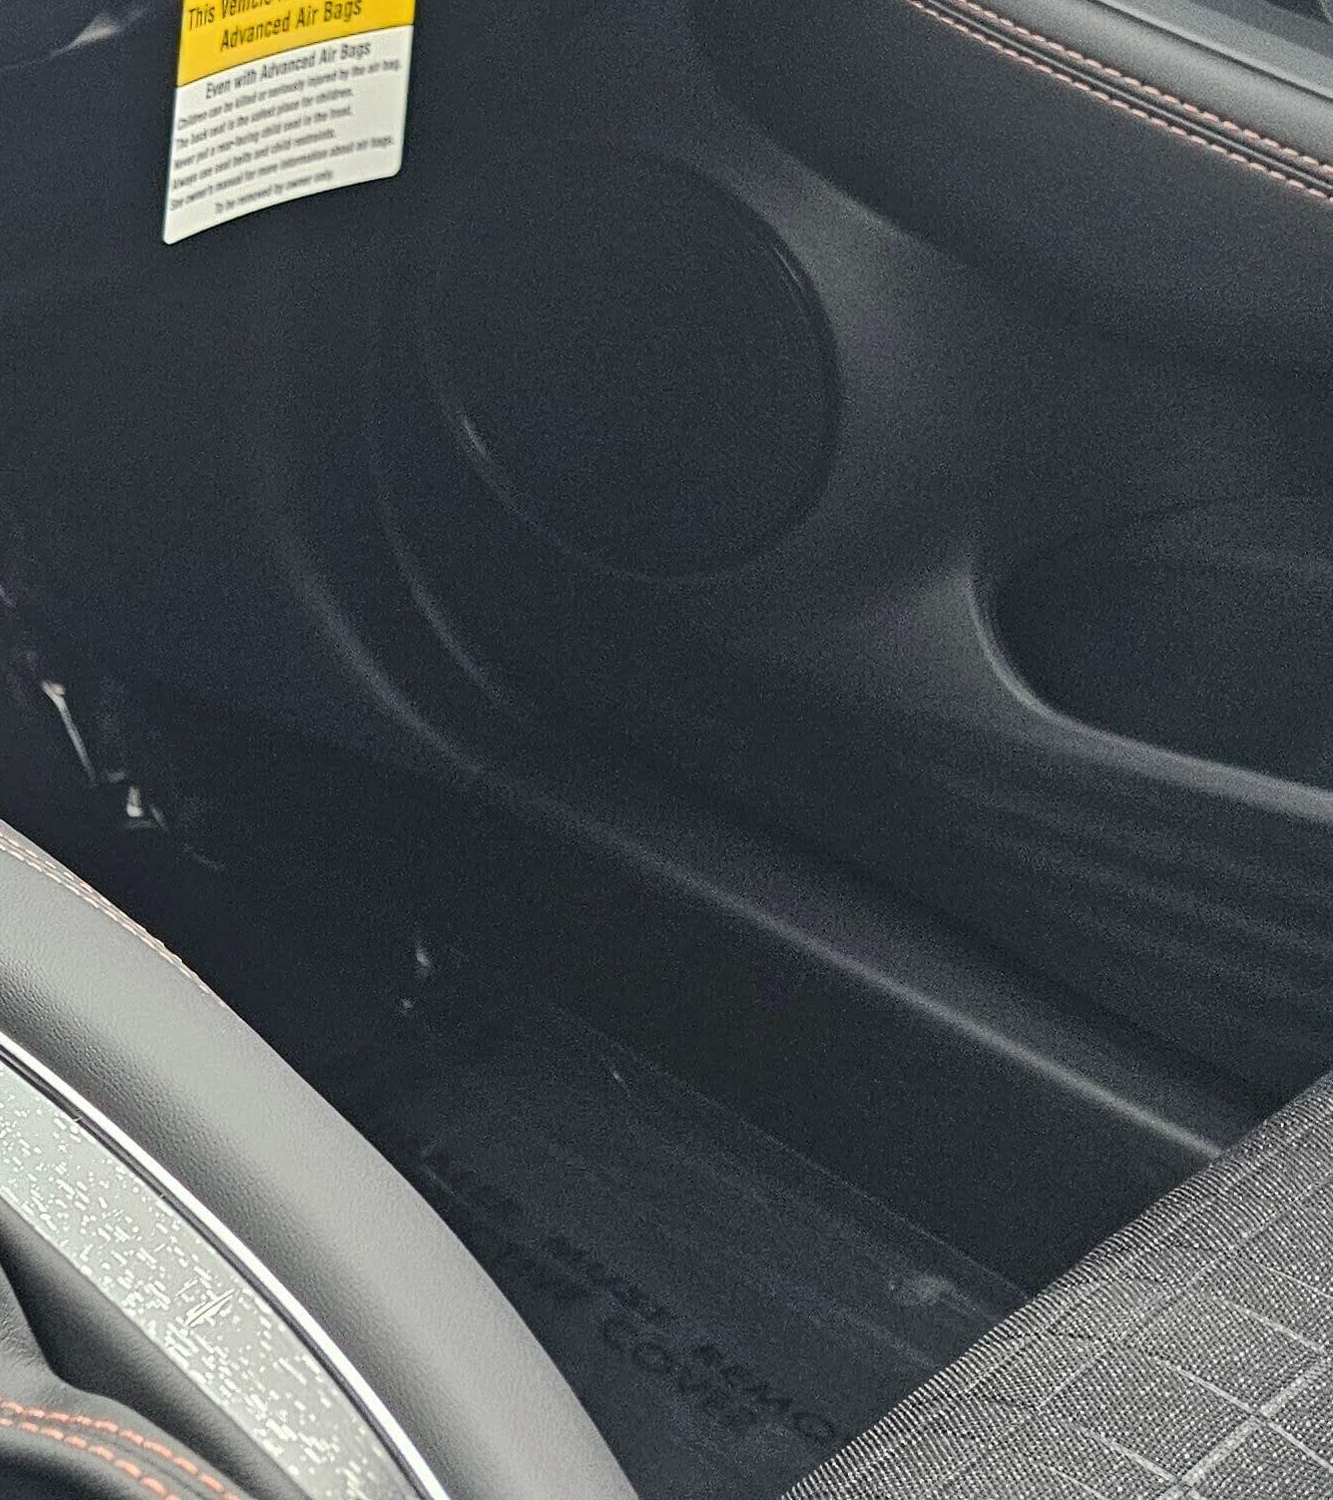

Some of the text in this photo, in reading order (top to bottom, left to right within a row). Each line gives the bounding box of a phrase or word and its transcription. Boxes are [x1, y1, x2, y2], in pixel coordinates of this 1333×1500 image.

[189, 4, 215, 32] This
[220, 0, 363, 52] Advanced Air Bags
[206, 43, 371, 99] Even with Advanced Air Bags
